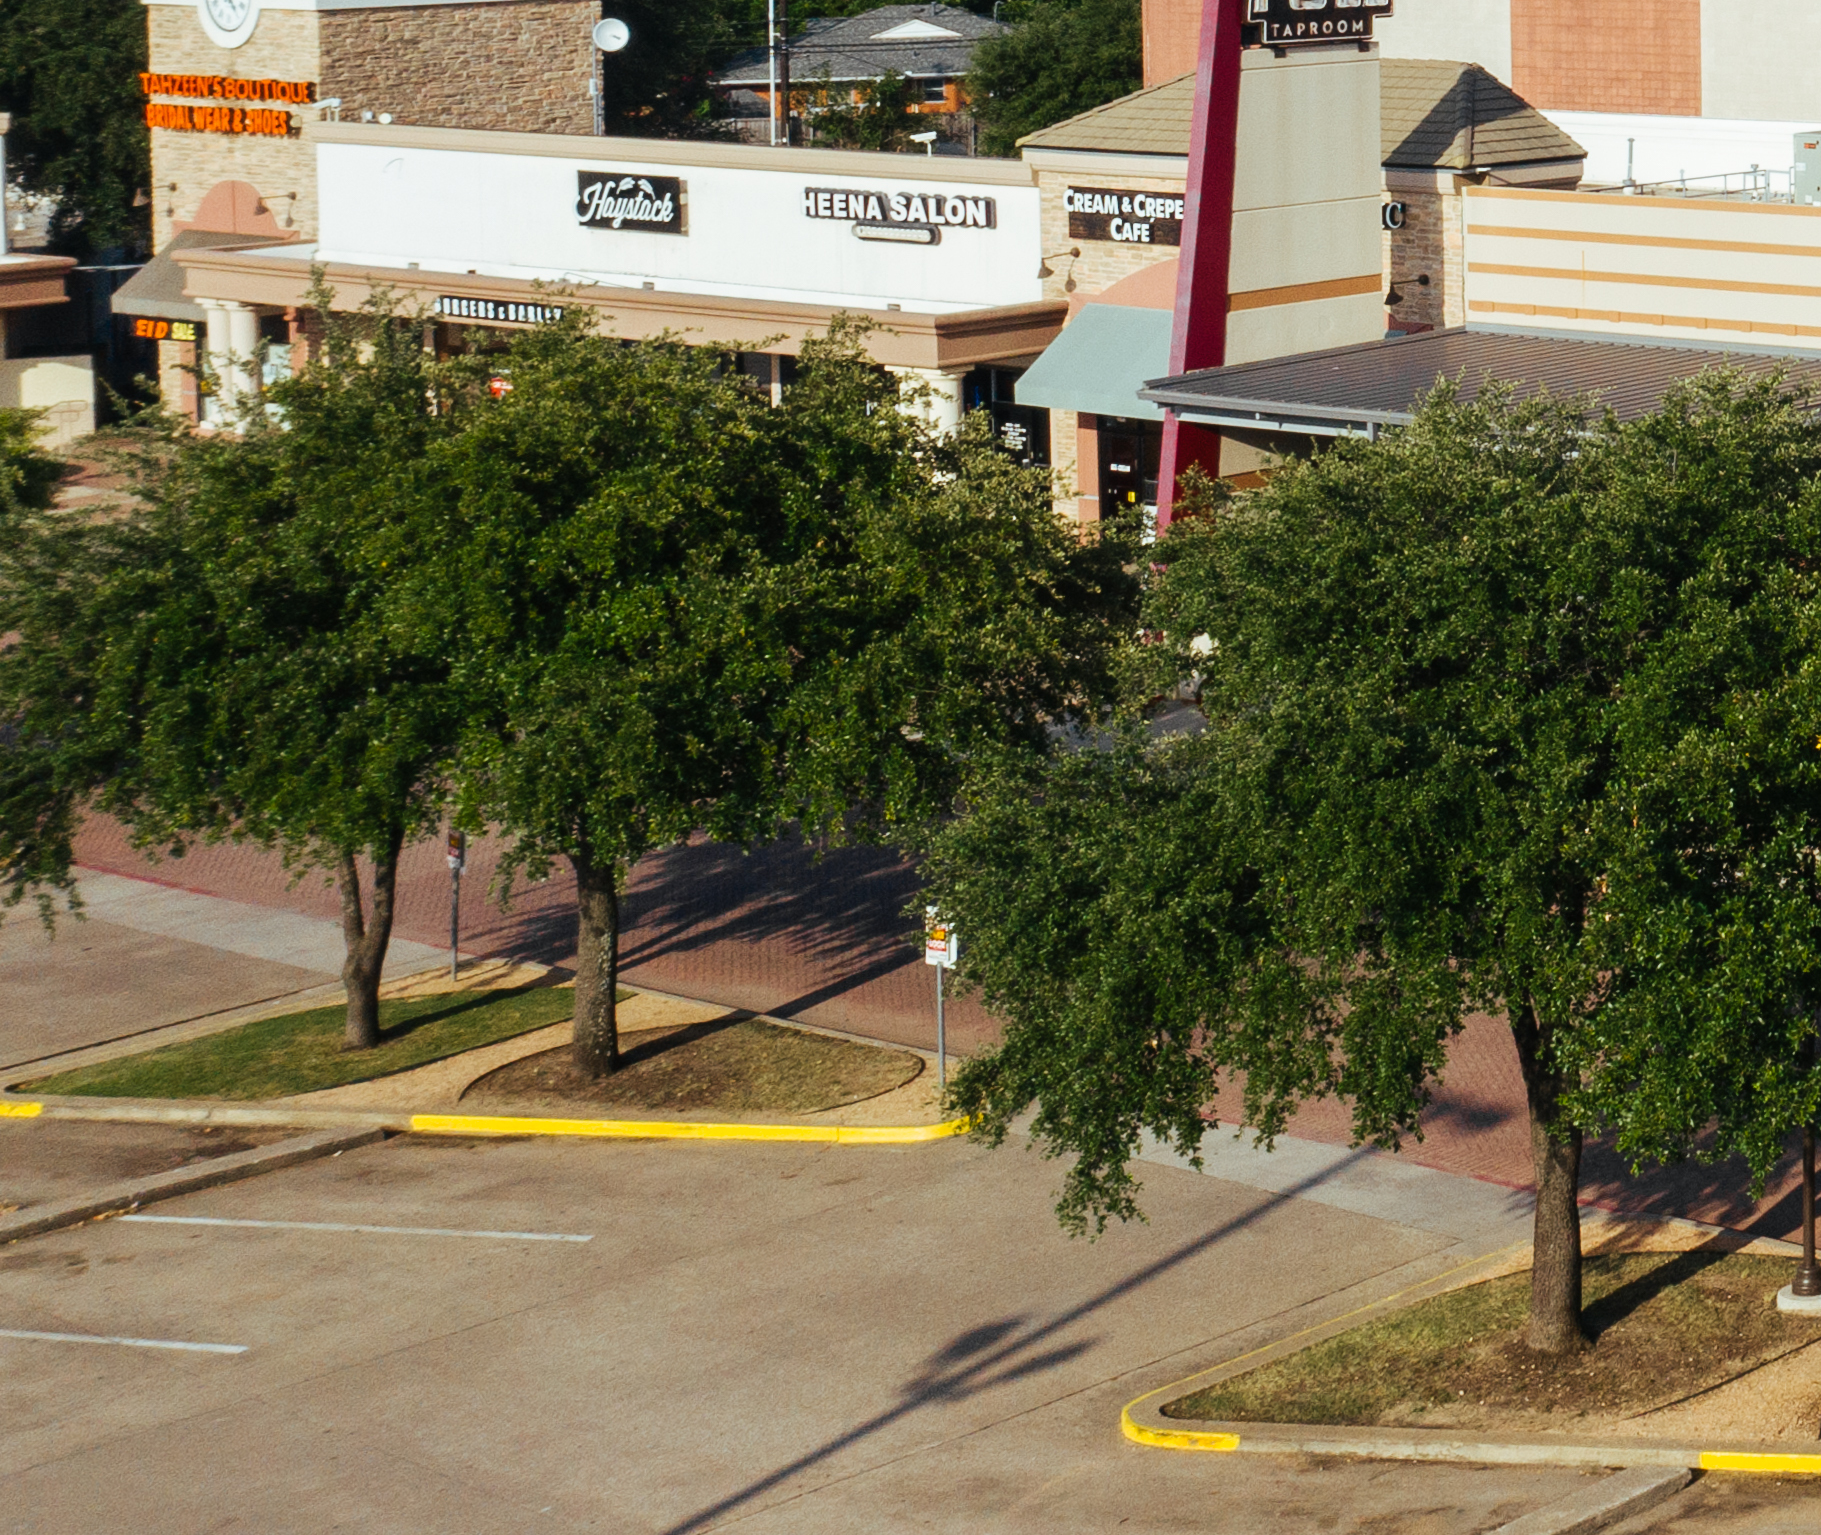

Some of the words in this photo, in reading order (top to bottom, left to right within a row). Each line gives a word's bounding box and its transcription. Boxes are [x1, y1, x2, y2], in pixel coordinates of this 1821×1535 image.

[1271, 20, 1364, 37] TAPROOM
[139, 72, 223, 97] TAHZEEN'S
[225, 78, 311, 103] BOUTIQUE
[145, 103, 192, 129] BRIDAL
[193, 106, 230, 132] WEAR
[232, 109, 243, 132] &
[245, 108, 287, 135] SHOES
[573, 180, 675, 229] Haystack
[801, 191, 882, 221] HEENA
[890, 195, 986, 226] SALON
[1063, 189, 1119, 215] CREAM
[1121, 196, 1132, 213] &
[136, 319, 169, 338] EID
